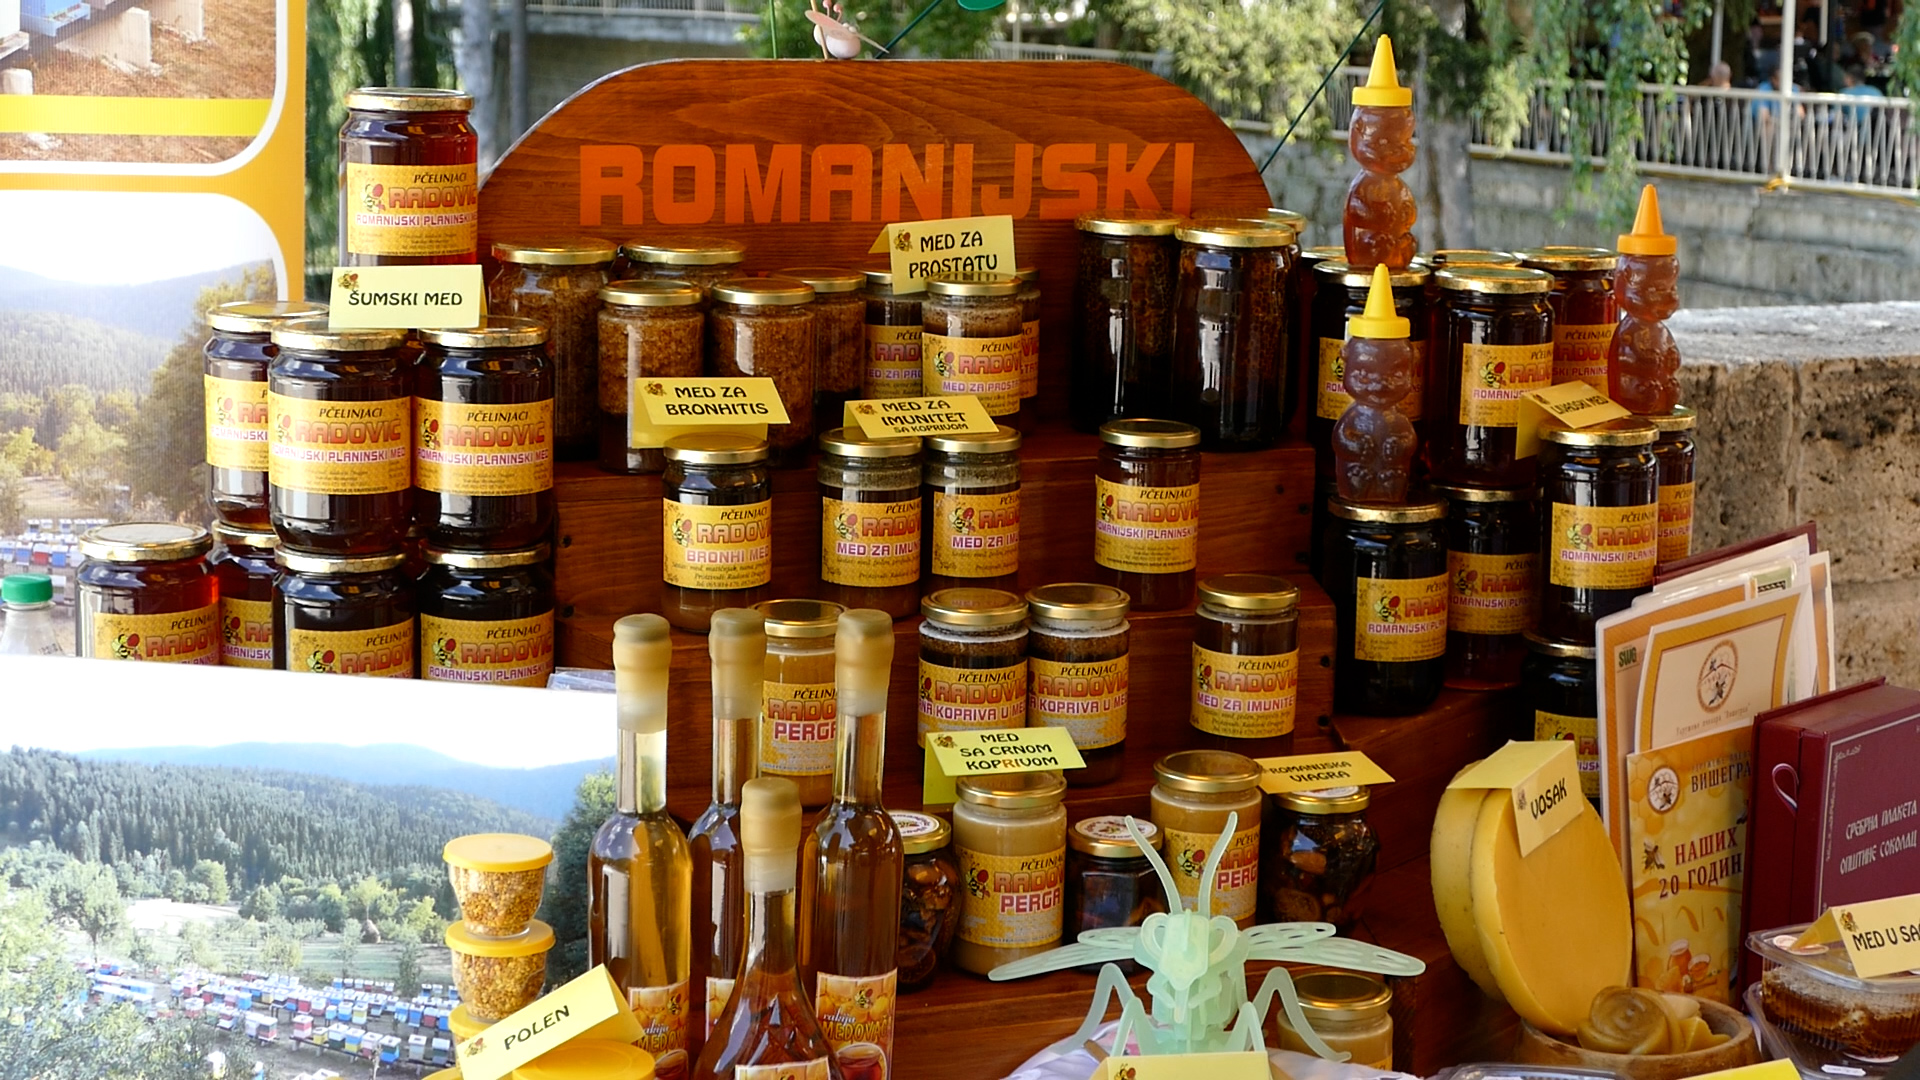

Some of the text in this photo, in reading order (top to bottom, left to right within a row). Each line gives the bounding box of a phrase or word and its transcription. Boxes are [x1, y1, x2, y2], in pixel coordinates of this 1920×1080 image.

[579, 142, 1196, 226] ROMANIJSKI
[920, 231, 983, 252] MED ZA
[909, 254, 998, 279] PROSTATU
[349, 289, 463, 306] ŠUMSKI MED
[674, 385, 747, 399] MED ZA
[942, 380, 965, 392] MED
[969, 381, 985, 392] ZA
[319, 407, 383, 419] PČELINJACI
[665, 402, 769, 417] BRONHITIS
[881, 400, 951, 412] MED ZA
[467, 410, 529, 423] PČELINJACI
[881, 412, 966, 426] IMUNITET
[893, 423, 969, 434] SA KOPRIVOM
[328, 448, 388, 462] PLANINSKI
[417, 447, 473, 465] ROMANIJSKI
[476, 453, 533, 465] PLANINSKI
[837, 542, 867, 556] MED
[872, 545, 891, 556] ZA
[952, 536, 983, 548] MED
[987, 536, 1004, 548] ZA
[687, 550, 745, 563] BRONHI
[1561, 550, 1624, 562] ROMANIJSKI
[1368, 621, 1428, 634] ROMANIJSKI
[429, 665, 492, 682] ROMANIJSKI
[958, 670, 1016, 684] PČELINJACI
[1060, 663, 1118, 677] PČELINJACI
[768, 697, 837, 721] RADO
[1039, 699, 1099, 714] KOPRIVA
[1103, 699, 1111, 711] U
[1197, 691, 1219, 708] MED
[1223, 699, 1242, 712] ZA
[936, 704, 997, 721] KOPRIVA
[1001, 706, 1009, 719] U
[980, 733, 1020, 743] MED
[960, 743, 1053, 758] SA CRNOM
[966, 755, 1059, 771] KOPRIVOM
[1289, 770, 1351, 783] VIAGRA
[1691, 760, 1752, 793] ВИШЕГРА
[1530, 777, 1568, 820] VOSAK
[1881, 799, 1917, 828] ПЛАКЕТА
[1675, 826, 1738, 866] НАШИХ
[1659, 874, 1680, 900] 20
[1000, 887, 1060, 913] PERGA
[1852, 930, 1885, 952] MED
[1887, 927, 1898, 946] U
[823, 1007, 856, 1027] rakija
[504, 1004, 570, 1051] POLEN
